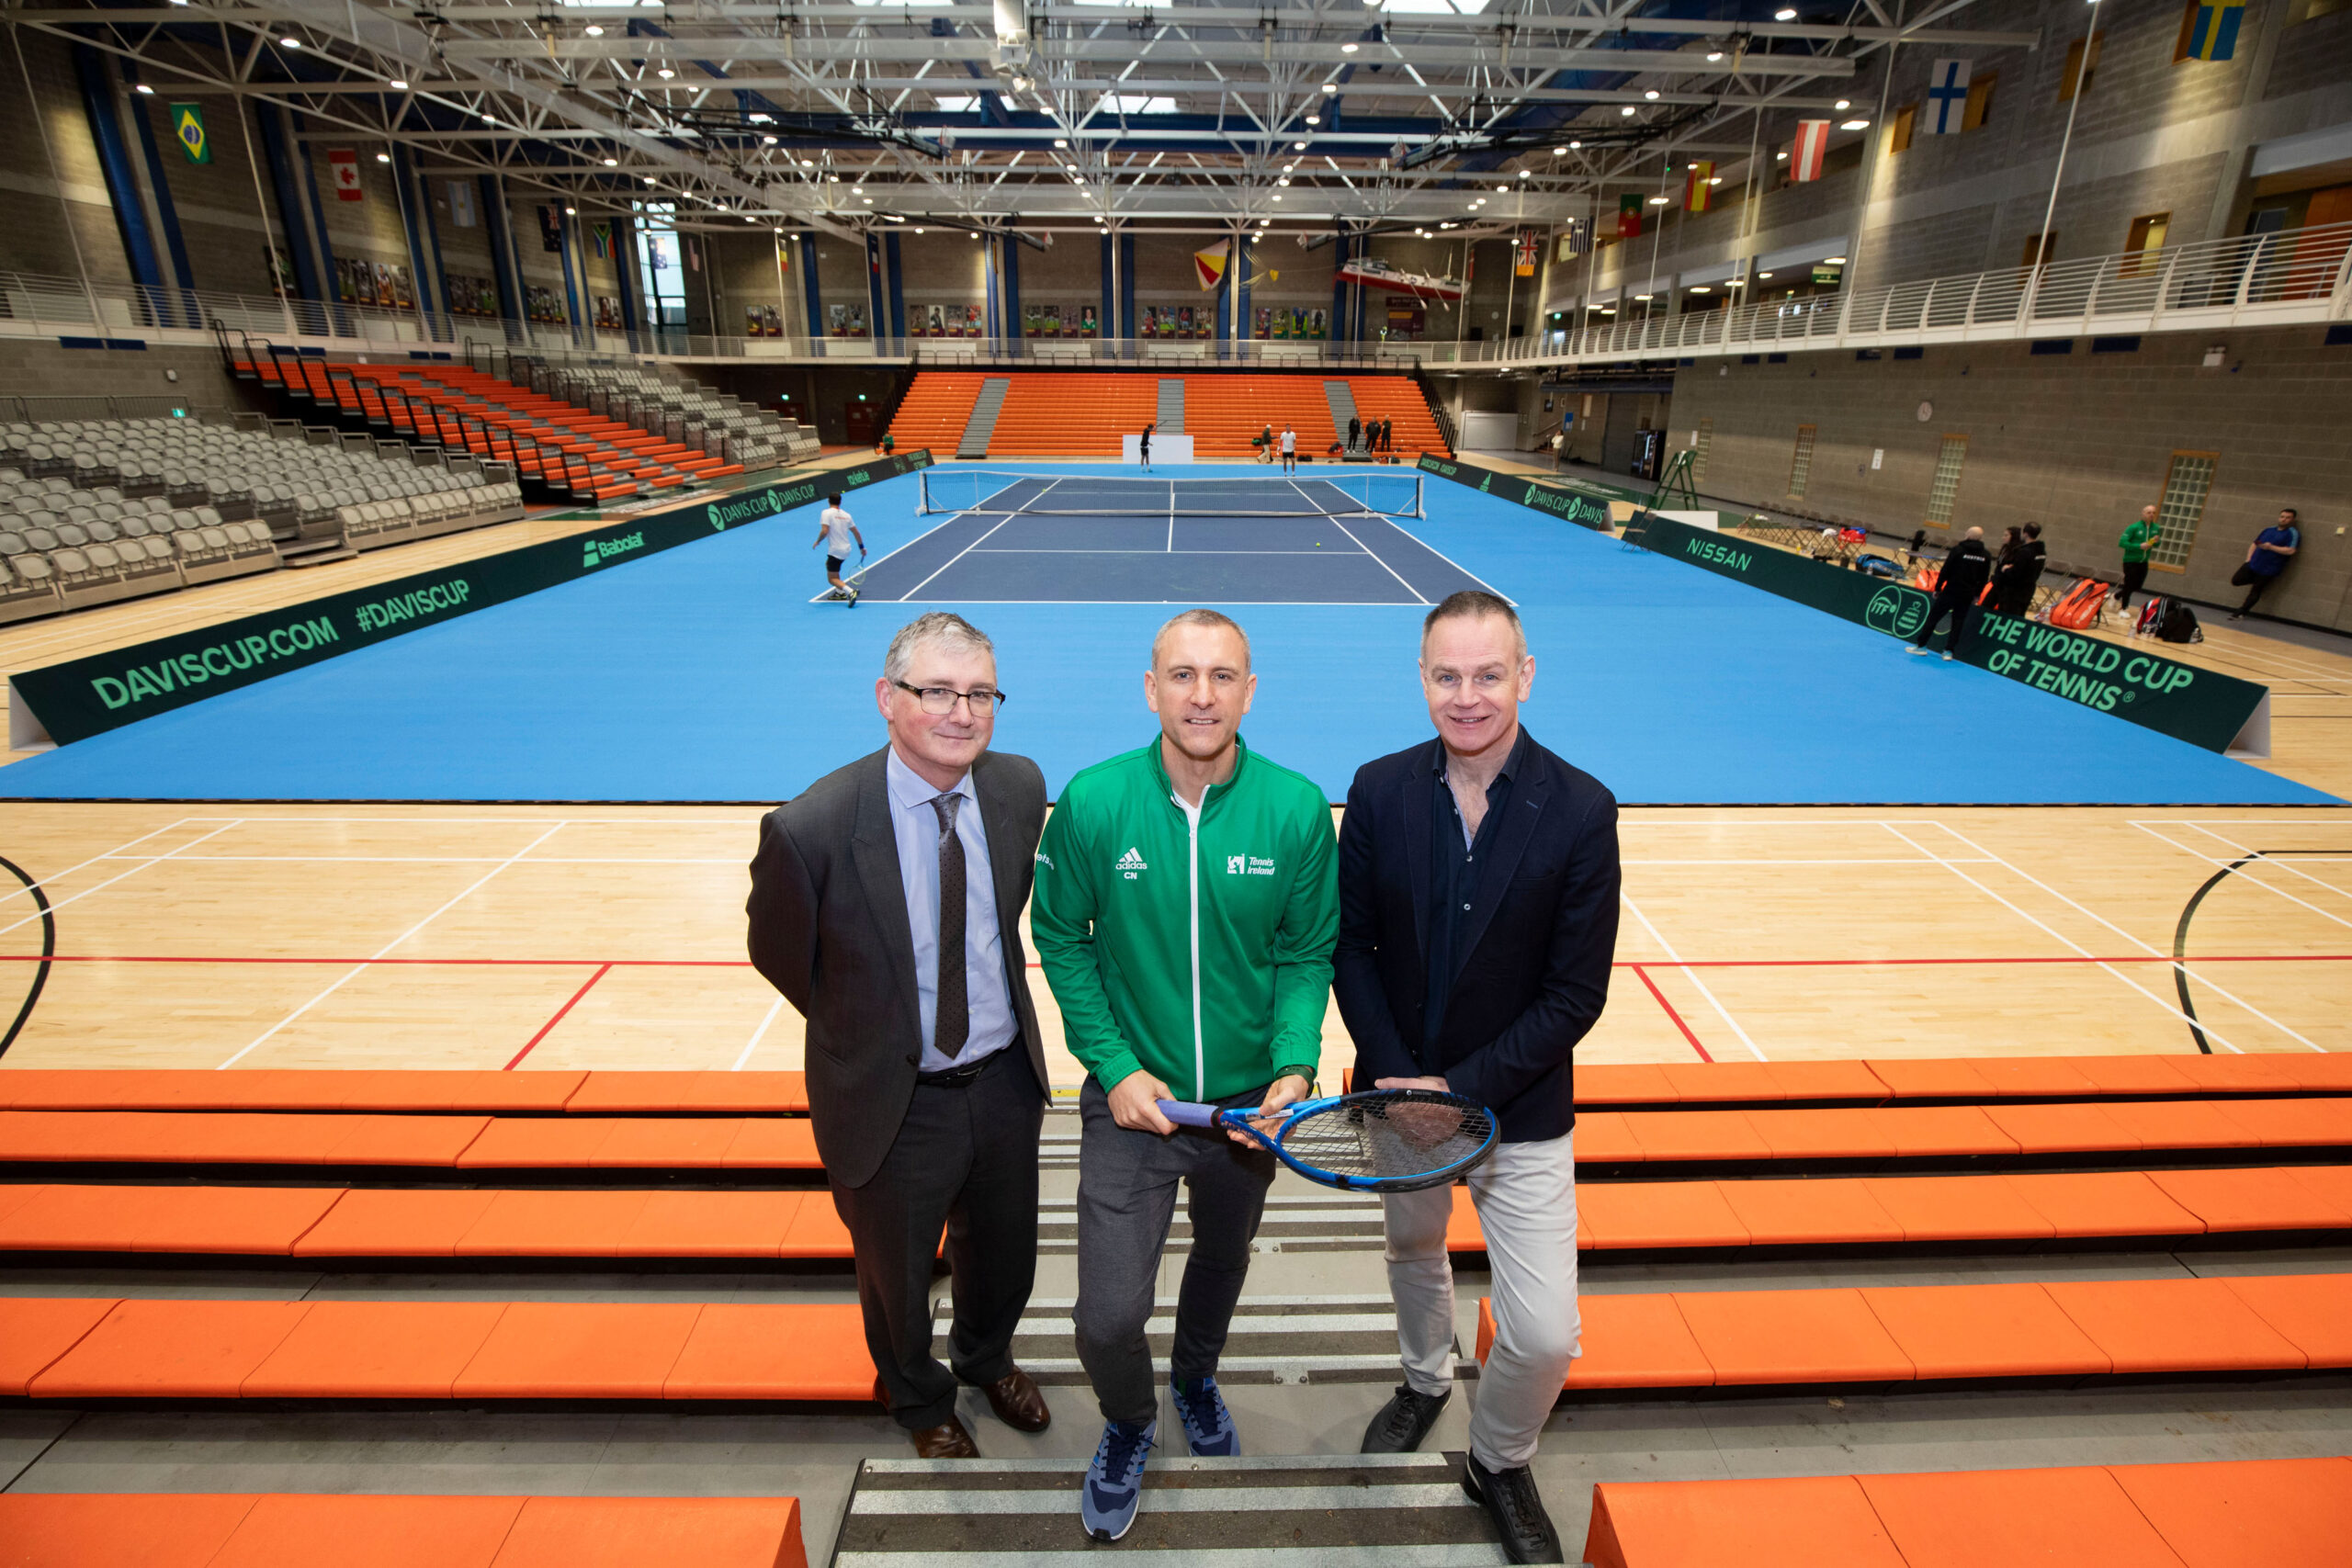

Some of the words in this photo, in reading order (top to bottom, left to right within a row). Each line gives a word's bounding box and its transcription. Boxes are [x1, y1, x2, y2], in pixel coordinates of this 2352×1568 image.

[779, 487, 802, 505] DAVIS
[800, 484, 816, 500] CUP
[1533, 491, 1555, 507] DAVIS
[1553, 496, 1571, 512] CUP
[721, 501, 752, 523] DAVIS
[749, 496, 769, 514] CUP
[1578, 503, 1605, 525] DAVIS
[597, 531, 645, 558] Babolat
[1686, 537, 1753, 572] NISSAN
[1870, 602, 1890, 615] ITF
[90, 615, 339, 710] DAVISCUP.COM
[356, 579, 469, 632] #DAVISCUP
[1978, 613, 2026, 645] THE
[2025, 626, 2120, 673] WORLD
[2124, 656, 2194, 694] CUP
[1988, 649, 2026, 676] OF
[1115, 861, 1148, 871] adidas
[1247, 865, 1275, 875] Ireland
[1249, 856, 1274, 866] Tennis
[1124, 872, 1137, 880] CN
